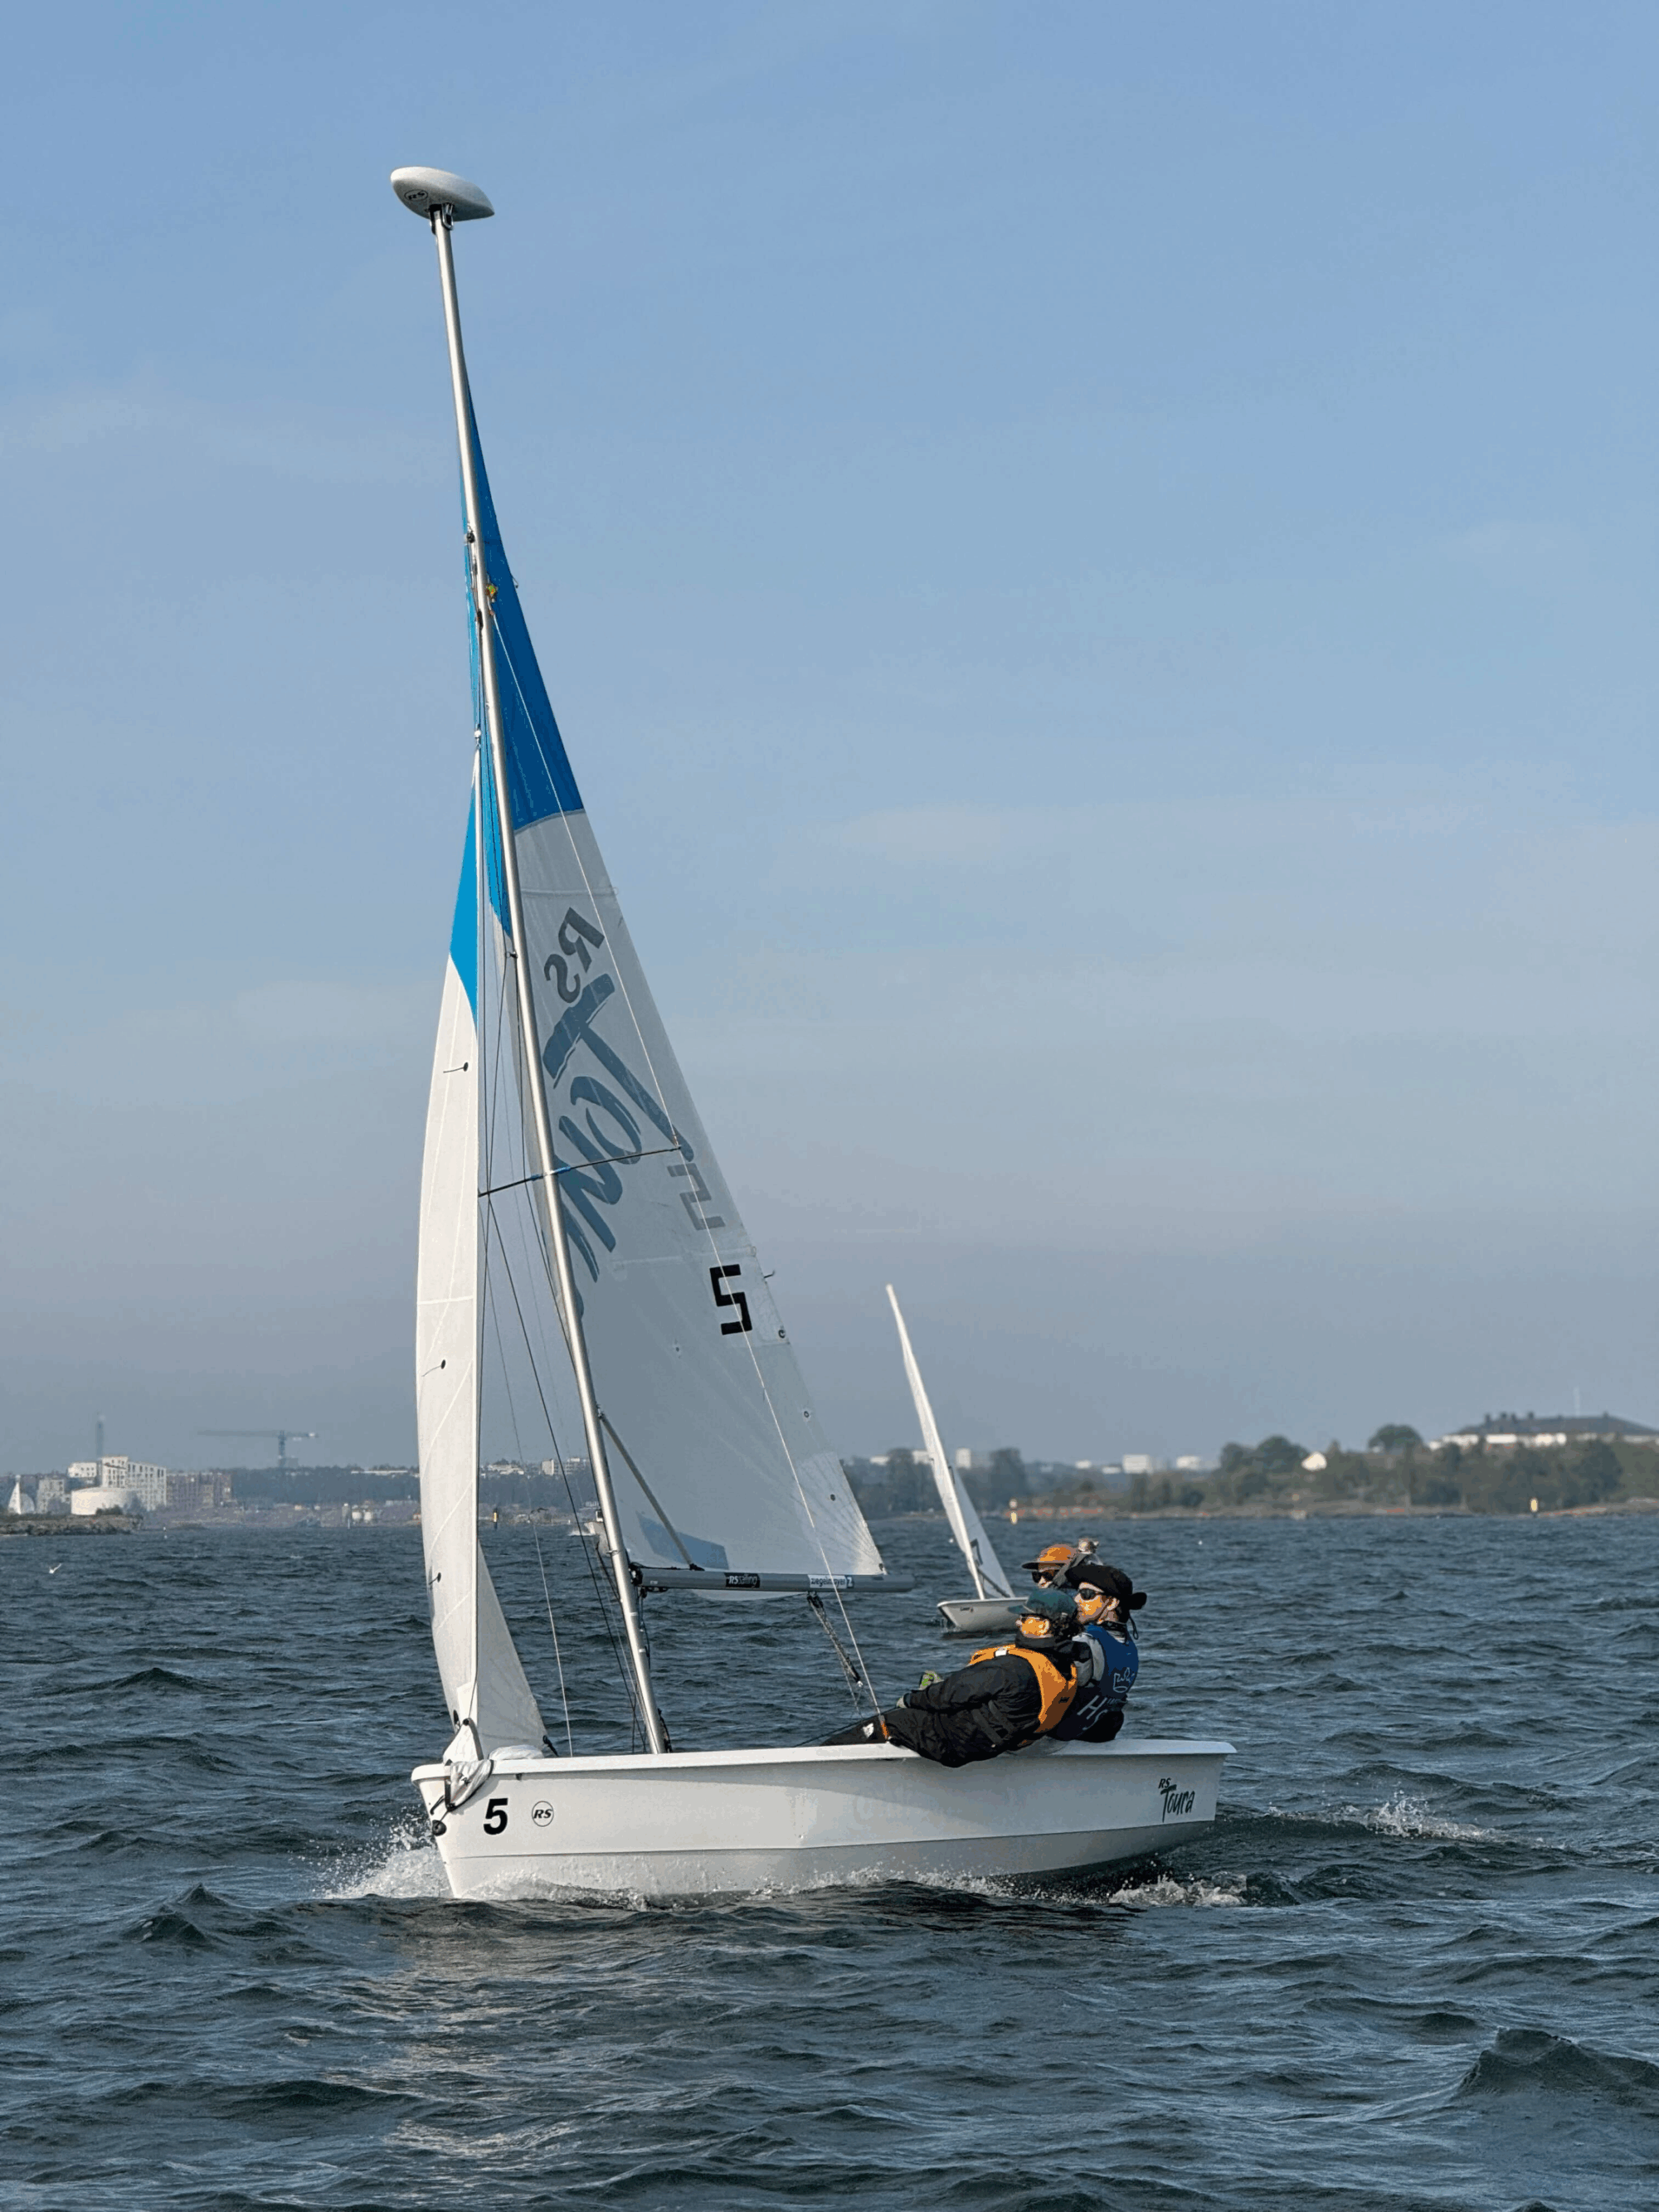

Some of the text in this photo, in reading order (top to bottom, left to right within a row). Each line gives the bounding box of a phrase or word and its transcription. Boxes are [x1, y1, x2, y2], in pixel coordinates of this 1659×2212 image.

[709, 1263, 753, 1335] 5
[1159, 1777, 1171, 1788] RS
[483, 1797, 508, 1835] 5
[533, 1809, 552, 1819] RS
[1160, 1784, 1195, 1823] Toura
